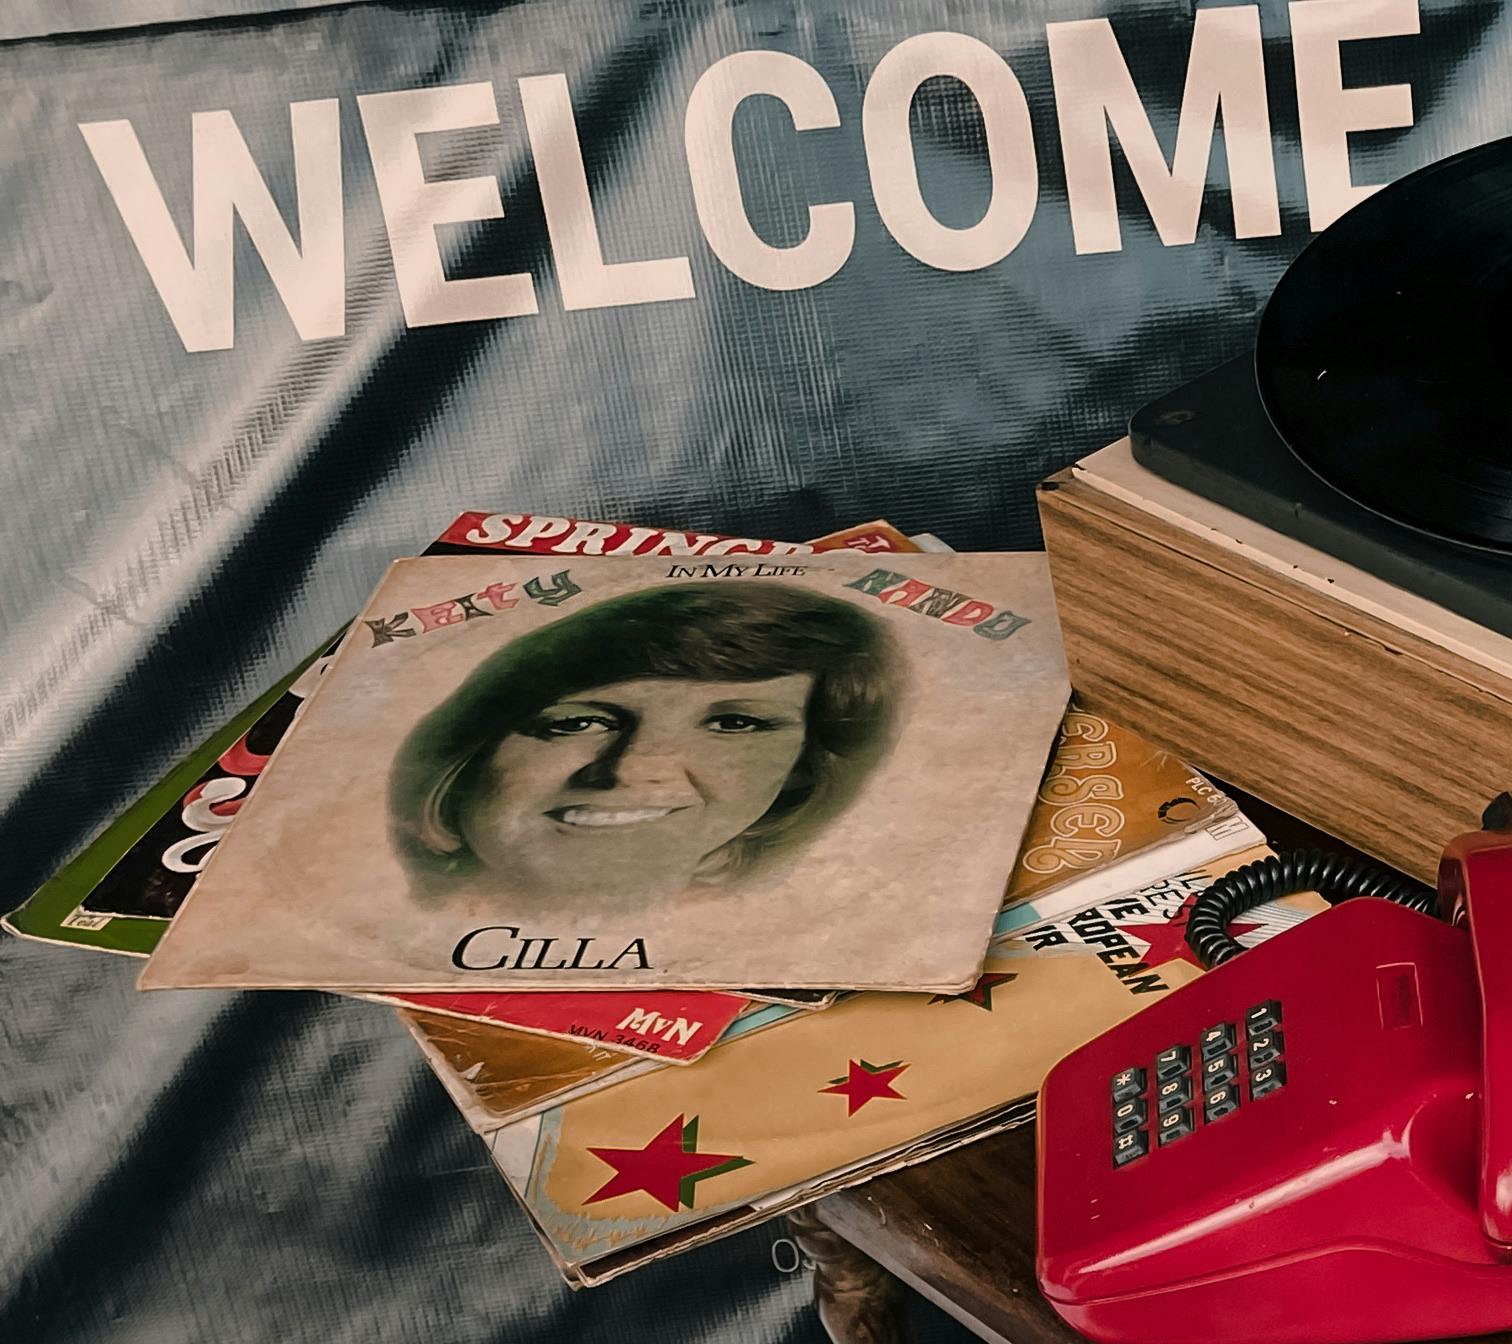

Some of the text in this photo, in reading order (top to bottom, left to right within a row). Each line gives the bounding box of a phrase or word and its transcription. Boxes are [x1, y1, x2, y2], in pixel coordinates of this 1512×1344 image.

[79, 0, 1423, 354] WELCOME
[700, 563, 749, 578] MY
[752, 562, 808, 578] LIFE
[451, 926, 655, 971] CILLA
[611, 1034, 661, 1054] 3468
[1206, 1030, 1226, 1105] 4 5 6
[1250, 1007, 1272, 1082] 1 2 3
[1117, 1104, 1133, 1117] 0
[1160, 1051, 1180, 1127] 7 8 9
